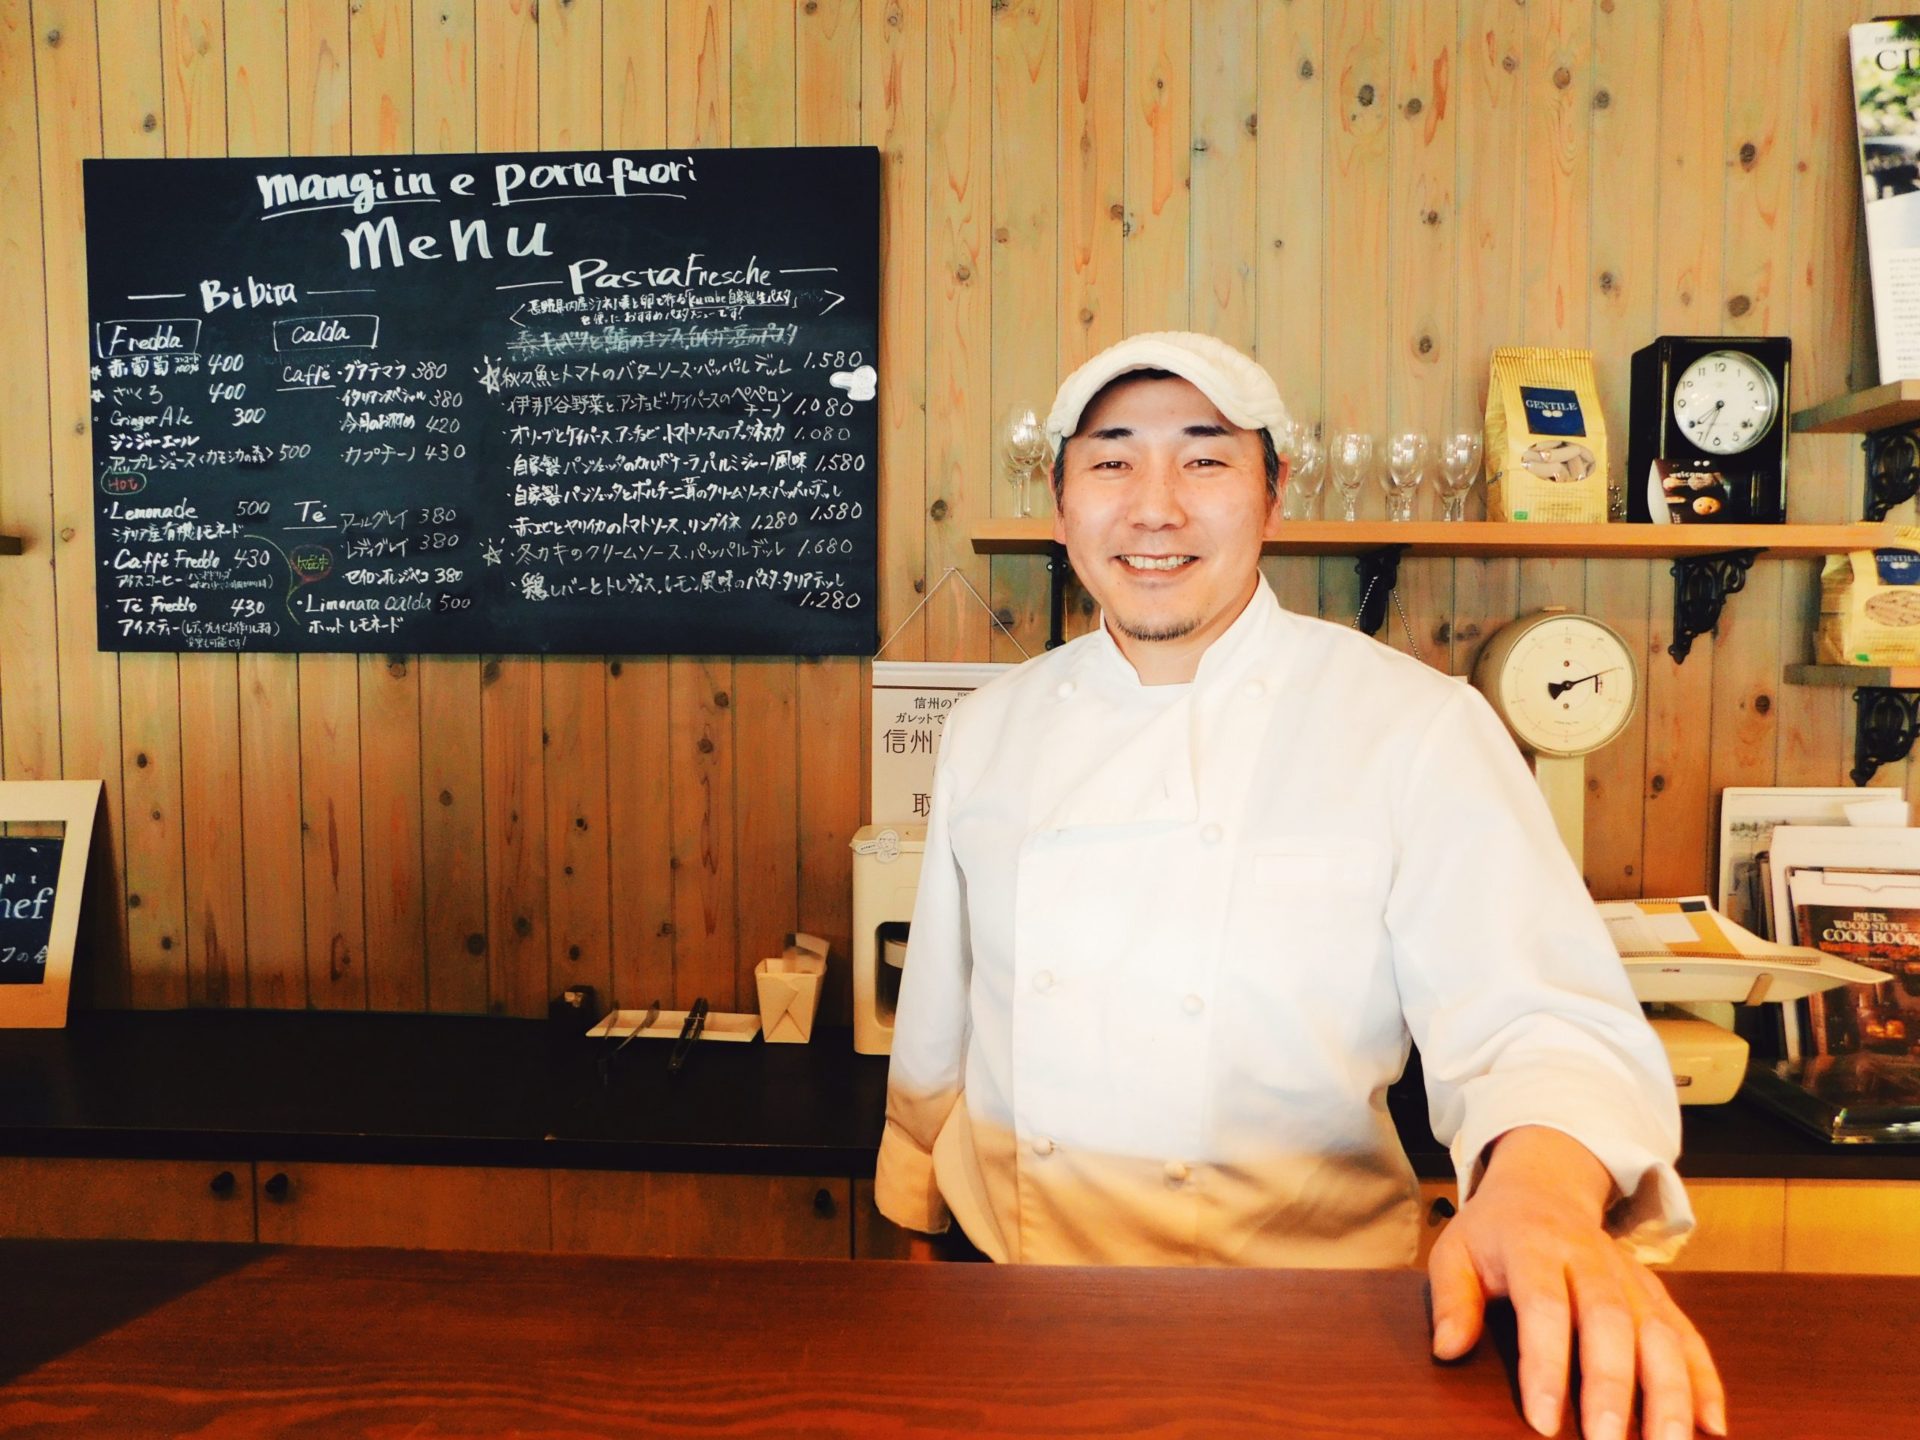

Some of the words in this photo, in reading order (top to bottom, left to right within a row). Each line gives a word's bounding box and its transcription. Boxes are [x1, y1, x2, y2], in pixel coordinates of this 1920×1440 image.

[450, 173, 476, 196] e
[200, 276, 298, 313] Bibita
[208, 354, 244, 375] 400
[411, 362, 448, 380] 380
[113, 385, 163, 405] ざくろ
[209, 383, 246, 403] 400
[429, 389, 463, 408] 380
[1525, 399, 1578, 412] GENTILE
[231, 408, 266, 427] 300
[425, 415, 461, 434] 420
[109, 433, 200, 451] ジンジャーエール
[278, 443, 311, 461] 500
[424, 444, 467, 461] 430
[110, 497, 199, 521] Lemonade
[236, 501, 271, 516] 500
[418, 507, 457, 524] 380
[419, 532, 459, 550] 380
[234, 549, 270, 569] 430
[434, 567, 463, 584] 380
[230, 598, 265, 618] 430
[439, 594, 471, 611] 500
[308, 614, 404, 634] ホットレモネード
[895, 712, 945, 725] ガレットで
[882, 728, 932, 754] 信州
[1823, 928, 1871, 944] COOK
[1872, 930, 1920, 947] BOOK
